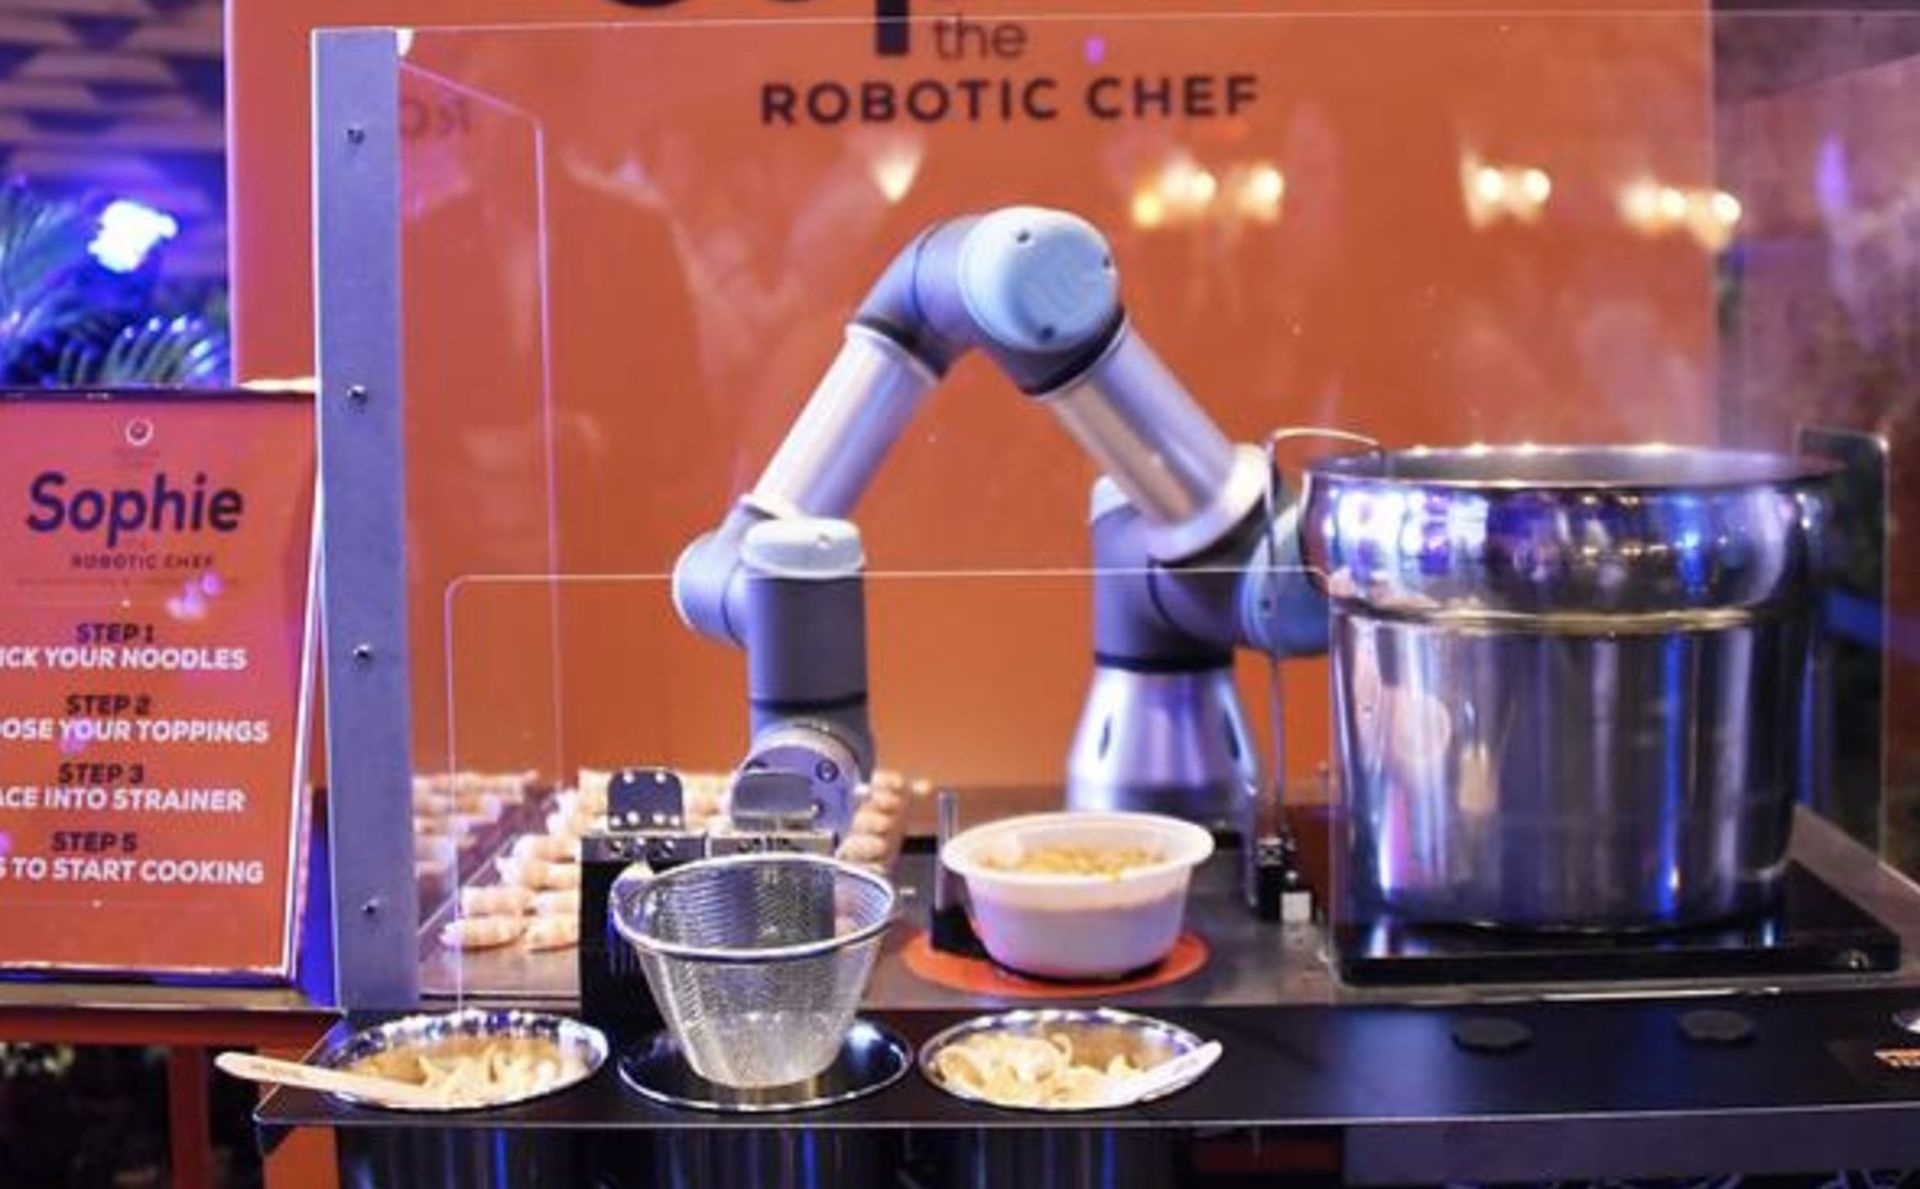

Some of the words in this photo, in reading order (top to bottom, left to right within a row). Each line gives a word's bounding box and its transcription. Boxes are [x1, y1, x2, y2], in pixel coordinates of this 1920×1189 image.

[934, 16, 1026, 58] the
[760, 78, 1058, 125] ROBOTIC
[1085, 73, 1258, 119] CHEF
[27, 470, 244, 548] Sophie
[71, 554, 157, 570] ROBOTIC
[77, 622, 139, 644] STEP
[44, 647, 115, 669] YOUR
[120, 648, 248, 671] NOODLES
[66, 694, 130, 716] STEP
[134, 695, 151, 716] 2
[59, 718, 132, 741] YOUR
[136, 720, 270, 744] TOPPINGS
[58, 763, 123, 784] STEP
[128, 763, 144, 784] 3
[44, 787, 108, 809] INTO
[112, 788, 247, 812] STRAINER
[51, 831, 117, 852] STEP
[121, 832, 138, 853] 5
[12, 857, 47, 880] TO
[52, 857, 137, 881] START
[140, 860, 264, 884] COOKING
